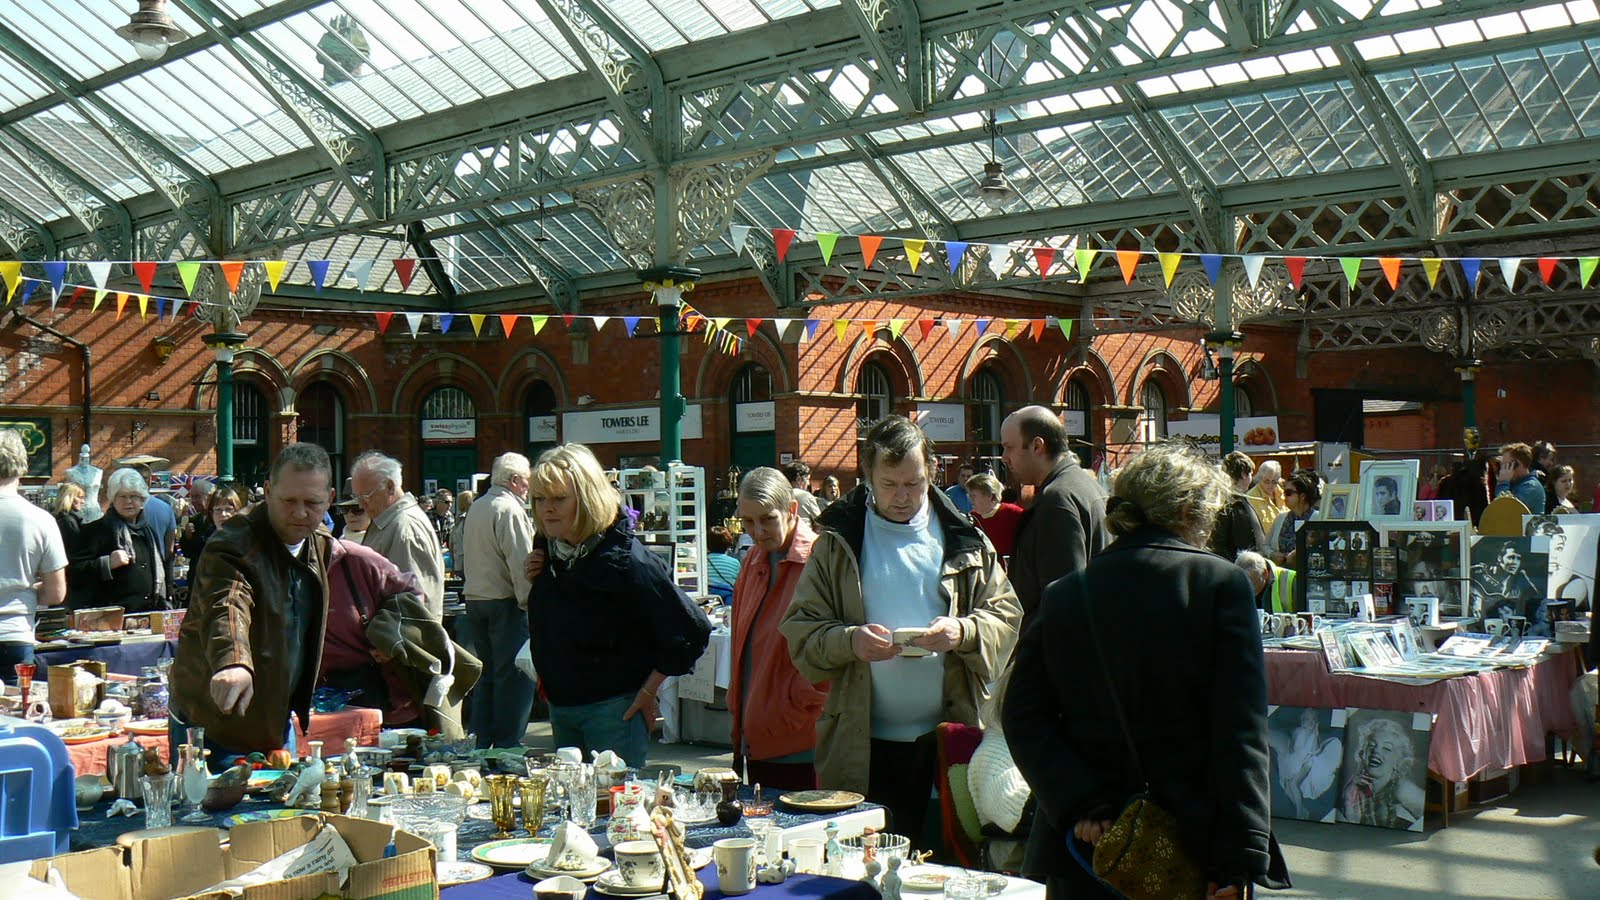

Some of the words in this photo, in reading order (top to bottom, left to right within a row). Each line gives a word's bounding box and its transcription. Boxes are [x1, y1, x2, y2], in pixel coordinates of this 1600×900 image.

[601, 416, 635, 428] TOWERS
[636, 416, 650, 426] LEE
[293, 866, 305, 876] now
[312, 854, 327, 865] rainy
[324, 856, 335, 866] and
